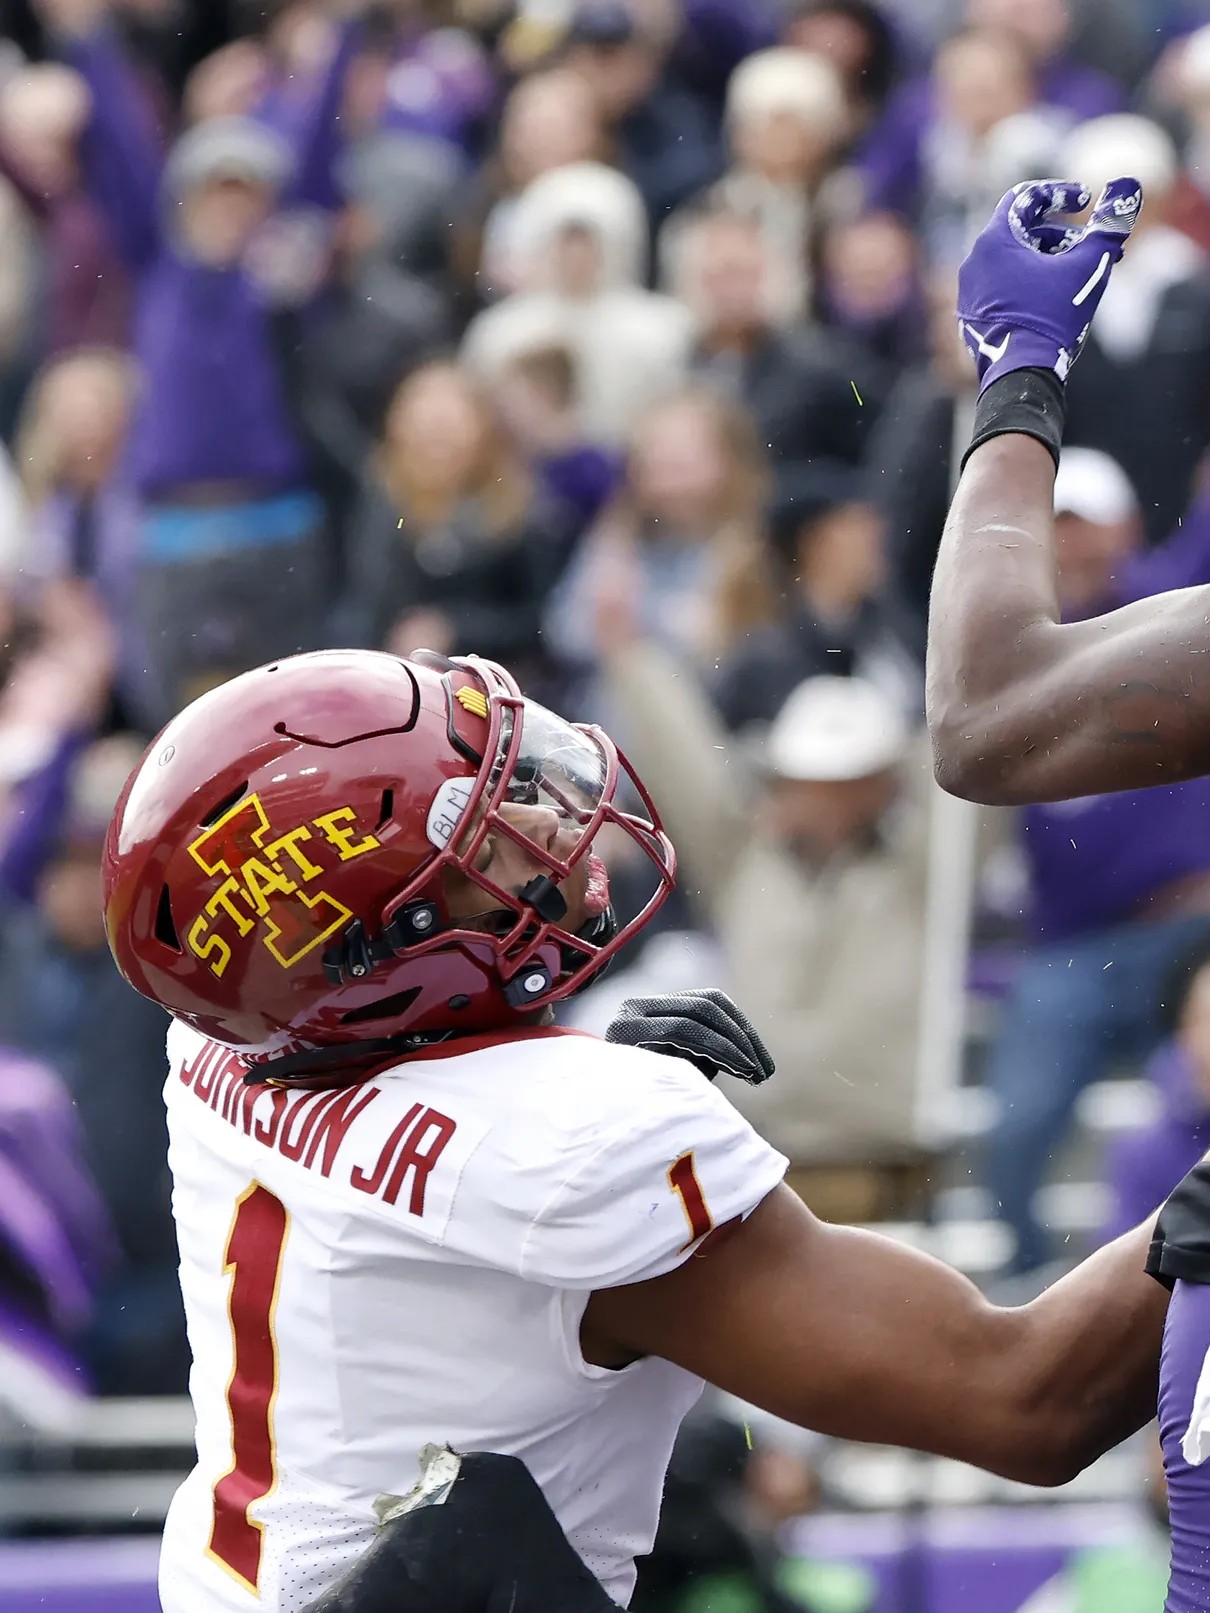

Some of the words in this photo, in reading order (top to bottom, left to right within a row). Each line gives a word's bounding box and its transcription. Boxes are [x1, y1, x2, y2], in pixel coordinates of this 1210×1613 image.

[187, 806, 381, 978] STATE
[350, 1102, 457, 1217] JR
[666, 1150, 717, 1256] 1
[203, 1177, 292, 1599] 1
